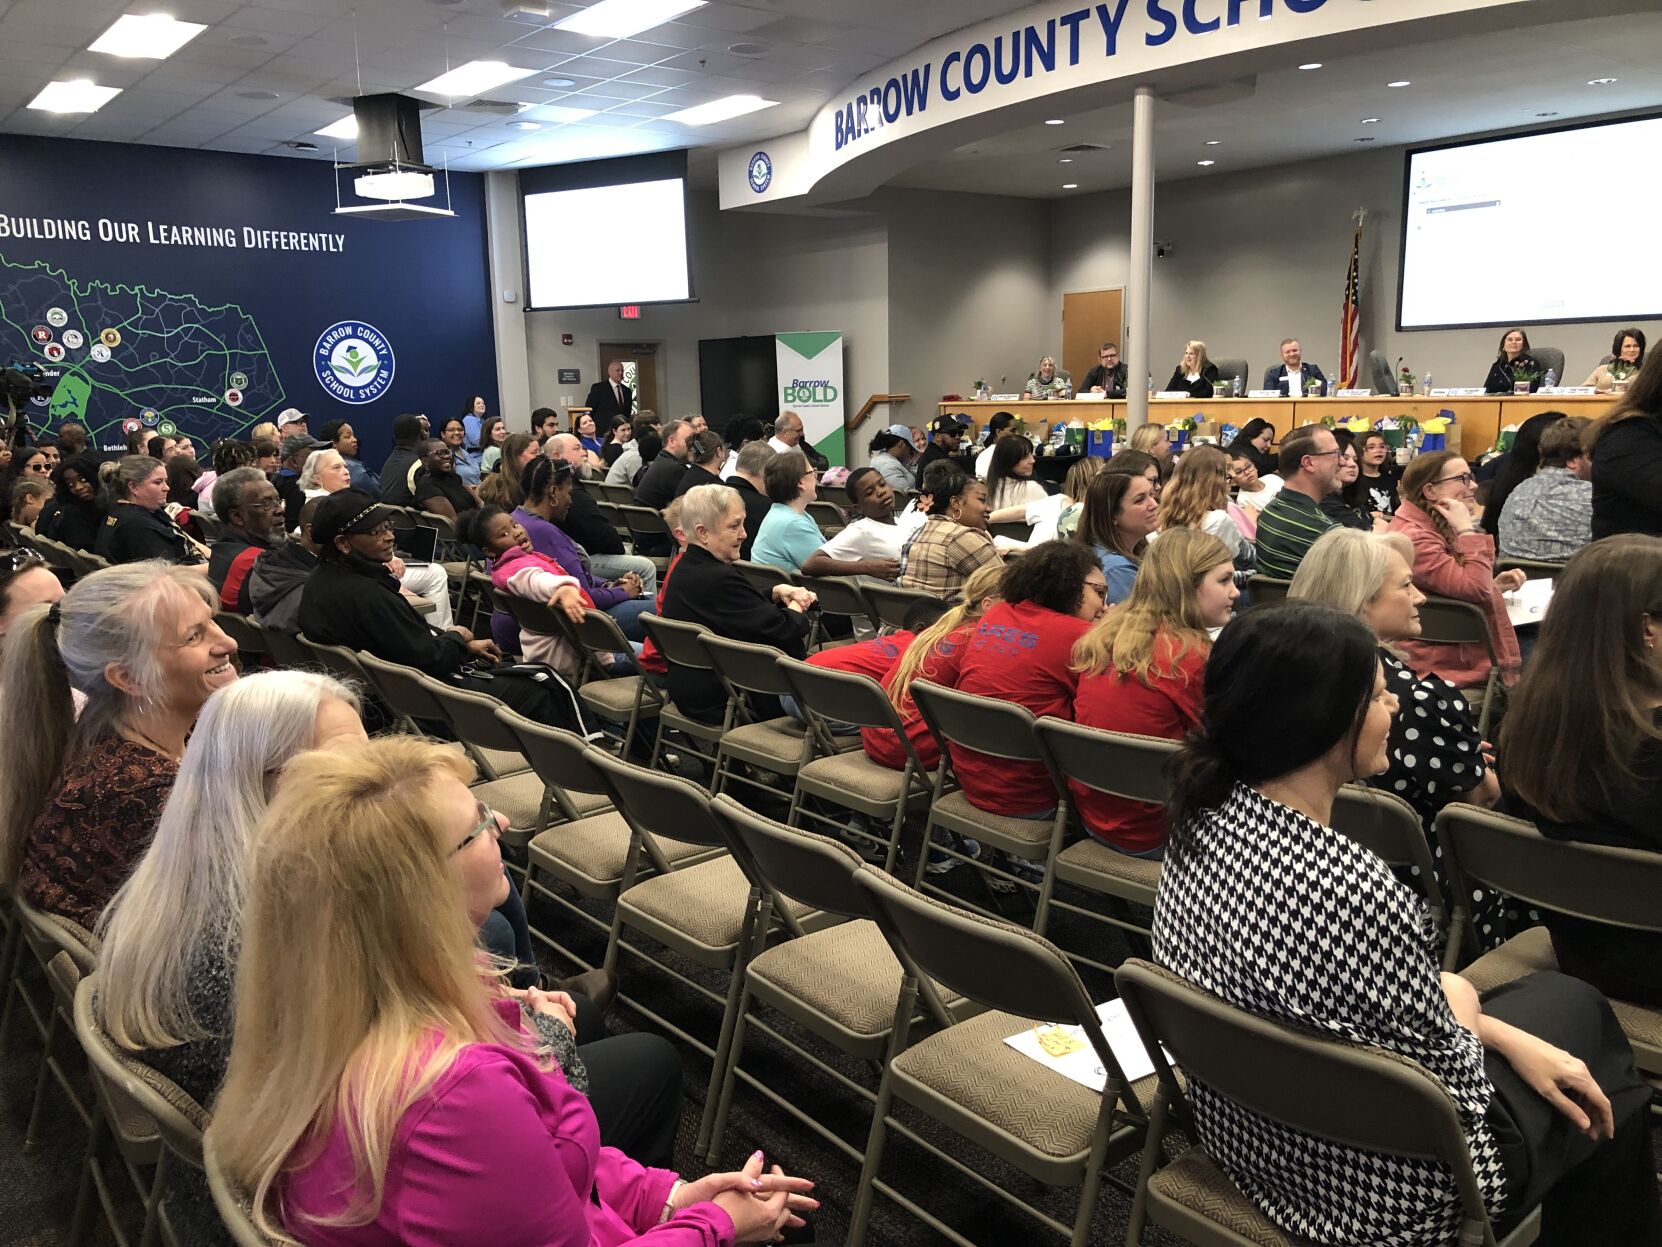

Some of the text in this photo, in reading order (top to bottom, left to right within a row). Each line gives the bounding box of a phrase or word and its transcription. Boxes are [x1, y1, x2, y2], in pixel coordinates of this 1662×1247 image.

[835, 63, 931, 151] BARROW
[940, 0, 1129, 101] COUNTY
[98, 218, 140, 243] OUR
[147, 221, 236, 248] LEARNING
[242, 226, 345, 252] DIFFERENTLY
[319, 325, 388, 356] BARROW COUNTY
[321, 369, 389, 399] SCHOOL SYSTEM
[783, 386, 838, 404] BOLD
[791, 378, 829, 388] Barrow
[103, 444, 128, 452] Bethleh
